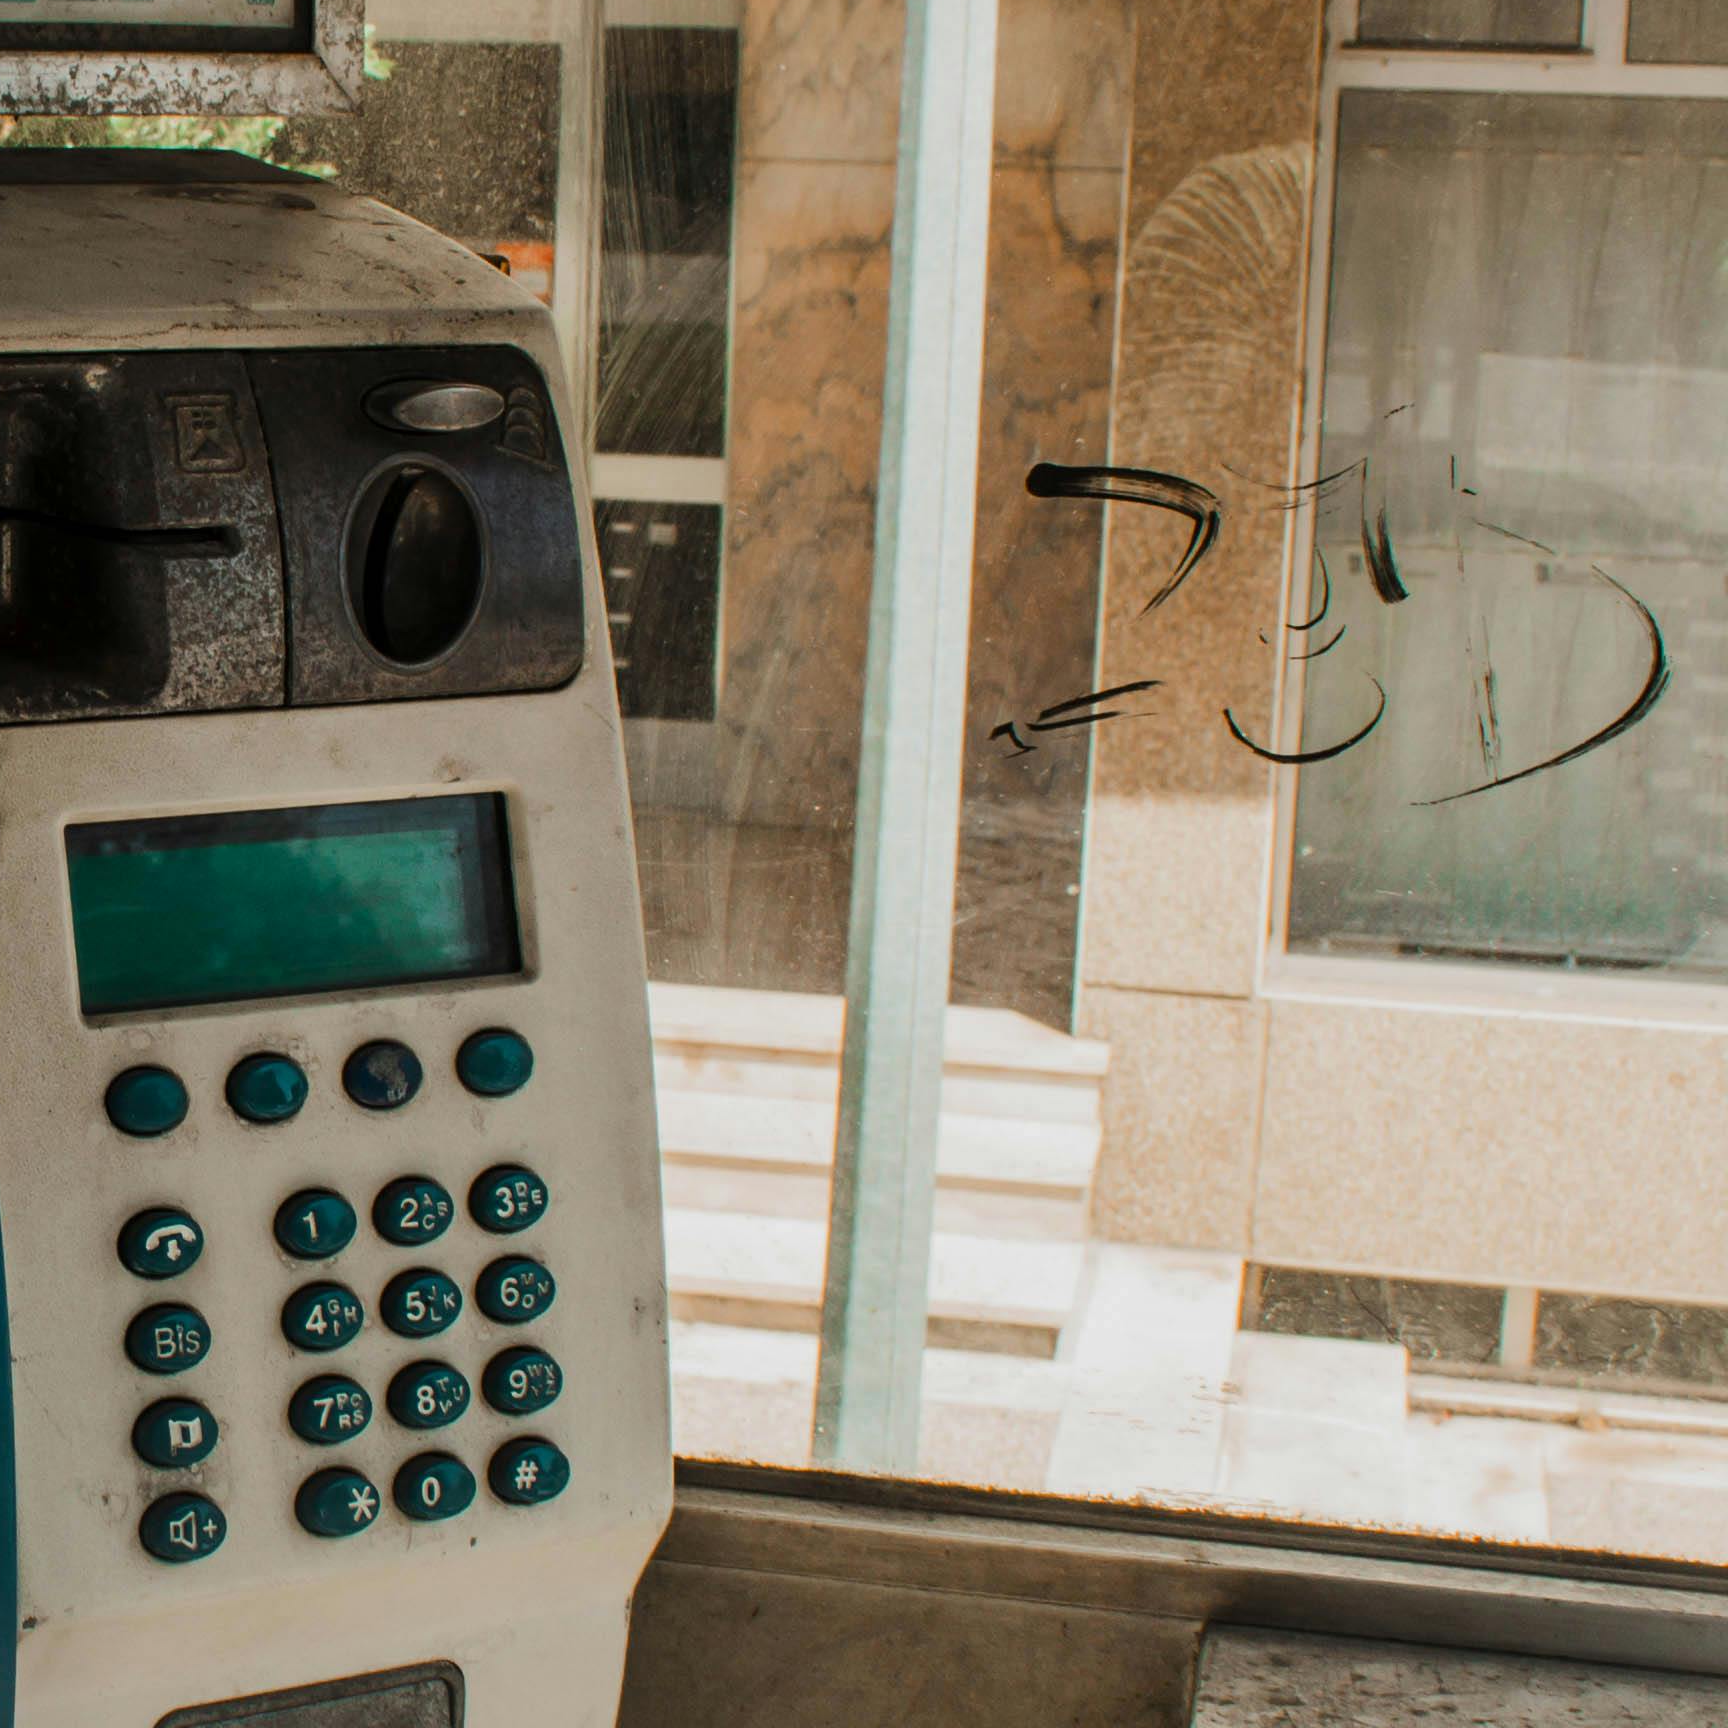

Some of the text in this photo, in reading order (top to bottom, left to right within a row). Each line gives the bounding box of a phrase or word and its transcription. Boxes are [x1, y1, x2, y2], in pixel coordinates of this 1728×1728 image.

[400, 1198, 419, 1229] 2
[495, 1186, 515, 1219] 3
[303, 1212, 319, 1240] 1
[405, 1290, 426, 1322] 5
[500, 1276, 519, 1307] 6
[304, 1304, 327, 1336] 4
[416, 1384, 436, 1416] 8
[509, 1370, 527, 1401] 9
[313, 1396, 334, 1430] 7
[514, 1459, 539, 1490] #
[421, 1476, 441, 1507] 0
